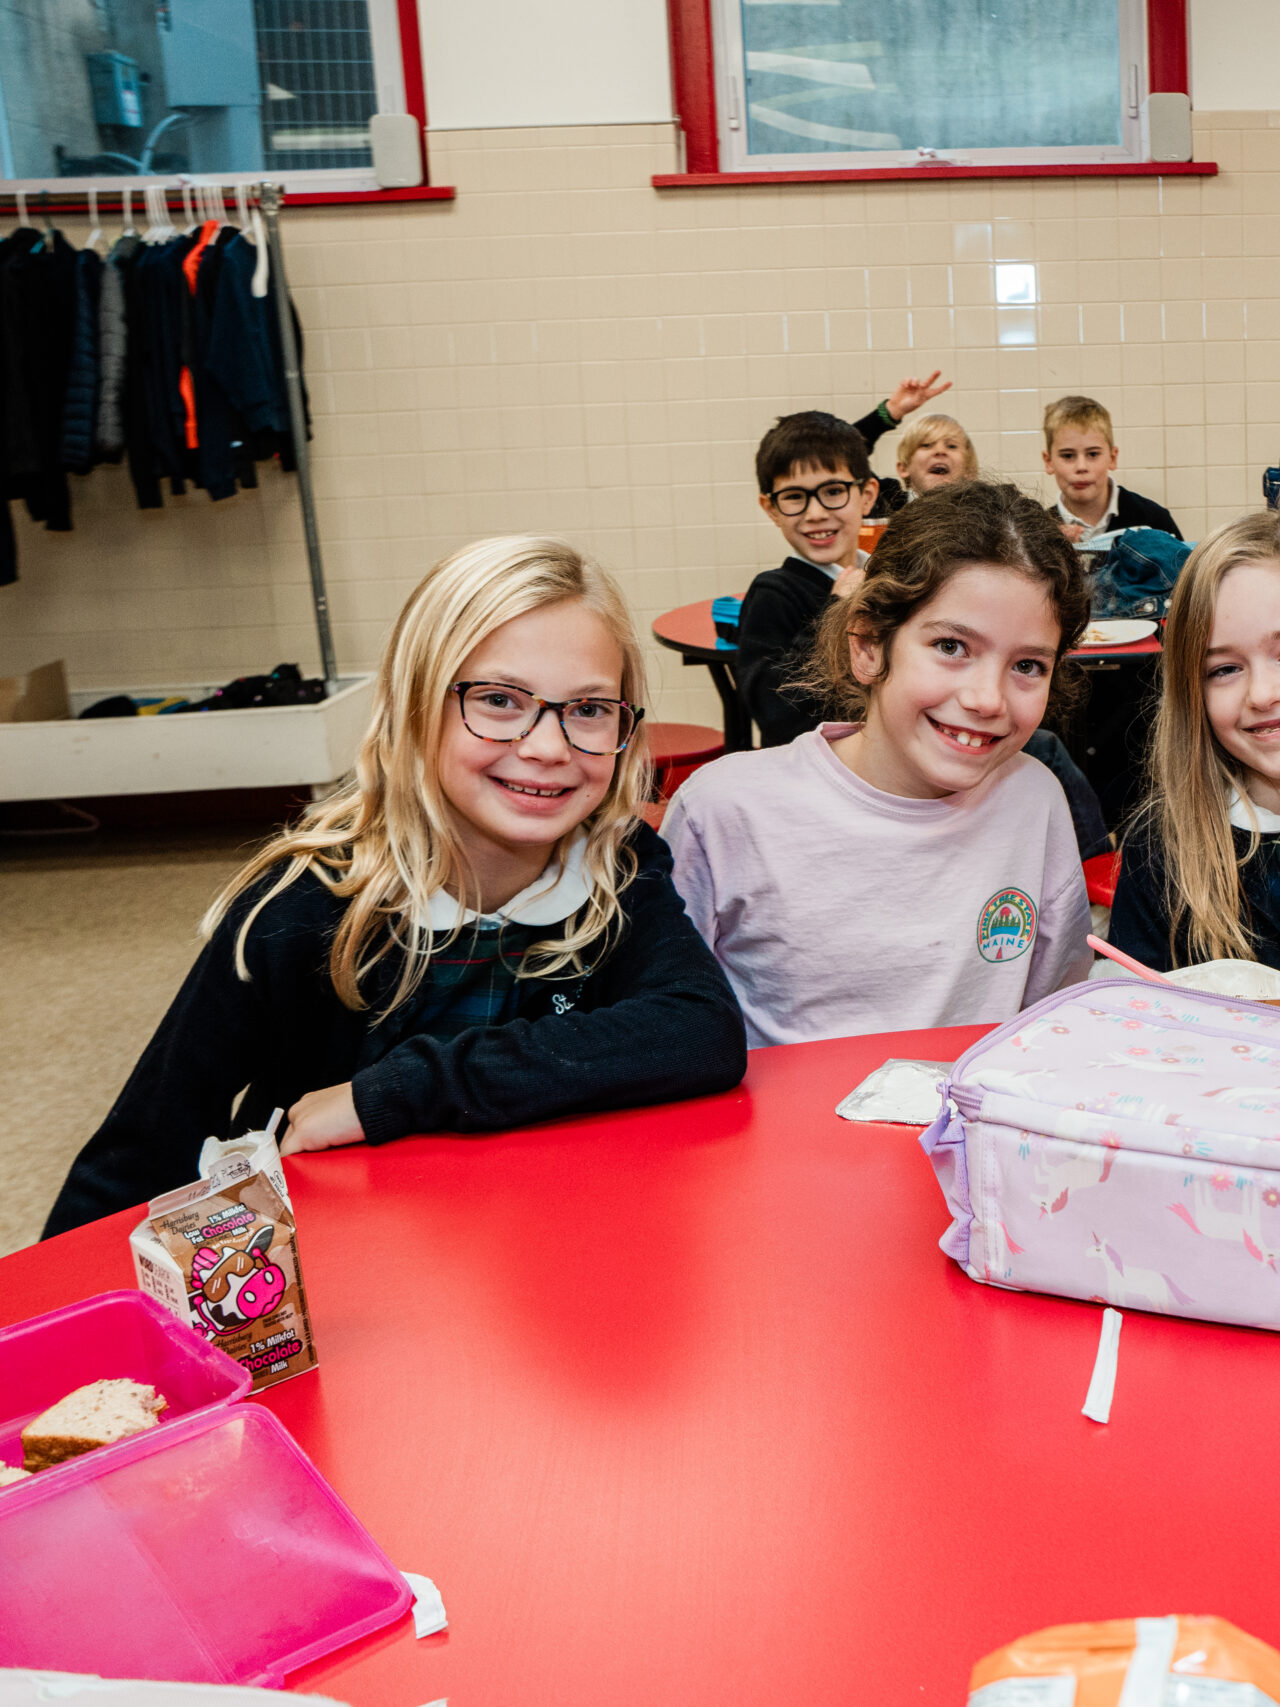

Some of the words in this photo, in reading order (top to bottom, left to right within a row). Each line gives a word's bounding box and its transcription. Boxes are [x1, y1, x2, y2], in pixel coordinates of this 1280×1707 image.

[982, 937, 1025, 950] MAINE
[160, 1212, 200, 1229] Harrisburg
[208, 1214, 222, 1224] 1%
[221, 1203, 247, 1220] Milkfat
[171, 1221, 197, 1235] Dairies
[202, 1213, 255, 1238] Chocolate
[231, 1226, 248, 1236] Milk
[183, 1229, 200, 1239] Low
[191, 1236, 205, 1244] Fat
[250, 1341, 265, 1354] 1%
[267, 1328, 295, 1348] Milkfat
[270, 1360, 289, 1374] Milk
